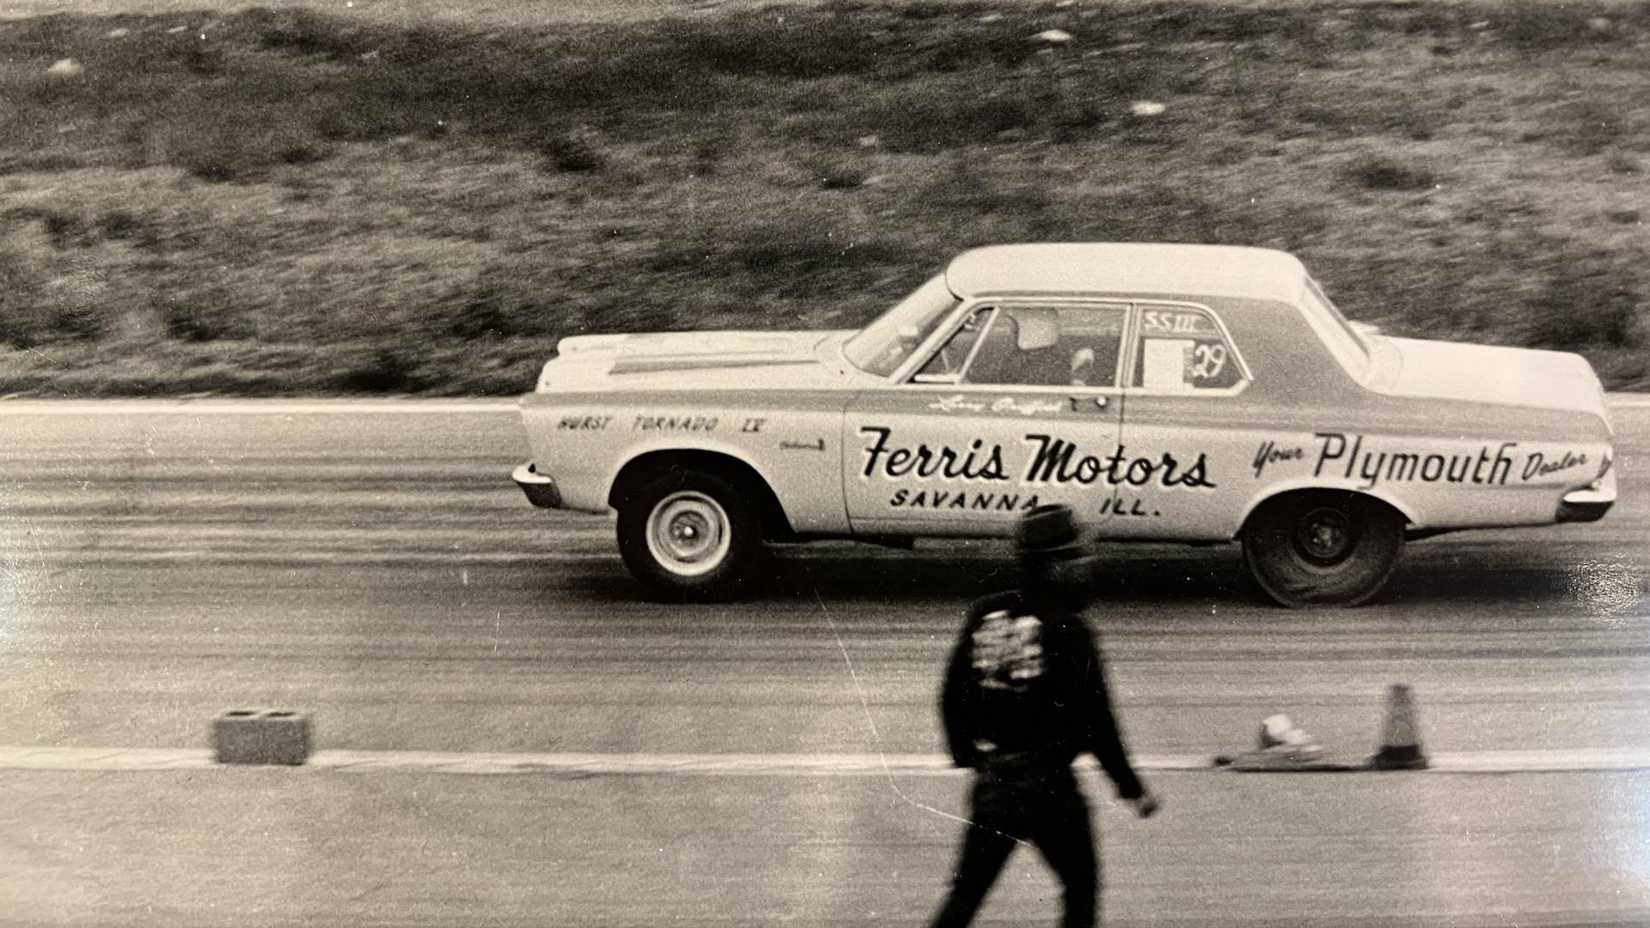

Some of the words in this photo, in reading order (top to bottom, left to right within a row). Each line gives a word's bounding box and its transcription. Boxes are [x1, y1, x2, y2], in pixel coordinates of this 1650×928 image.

[1193, 343, 1227, 379] 29
[557, 416, 612, 431] HURST
[633, 416, 720, 432] TORNADO
[860, 426, 1009, 481] Ferris
[1025, 434, 1217, 488] Motors
[1252, 440, 1304, 479] Your
[1314, 431, 1517, 491] Plymouth
[1521, 451, 1587, 481] Dealer
[890, 489, 1040, 511] SAVANNA
[1099, 498, 1160, 516] ILL.
